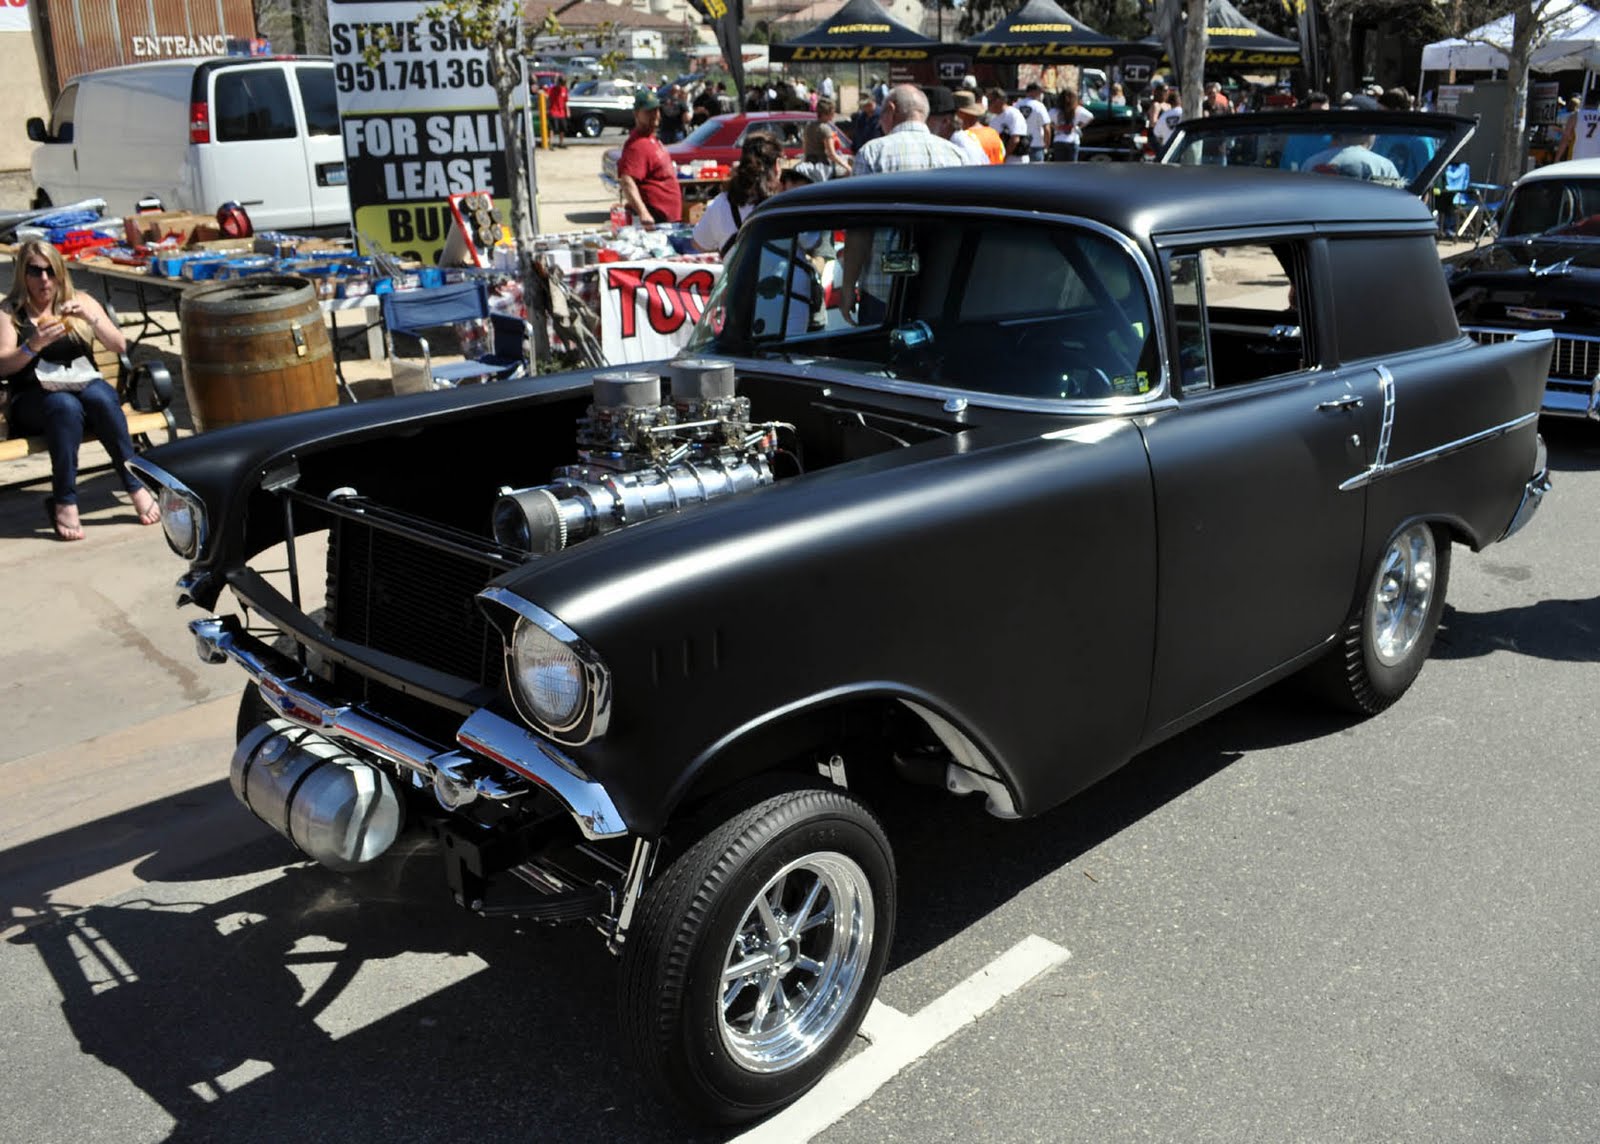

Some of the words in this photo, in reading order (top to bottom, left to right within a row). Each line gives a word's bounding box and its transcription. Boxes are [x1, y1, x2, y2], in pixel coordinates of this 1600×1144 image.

[132, 35, 234, 57] ENTRANC
[344, 117, 419, 158] FOR
[1586, 122, 1597, 138] 7
[384, 158, 494, 200] LEASE
